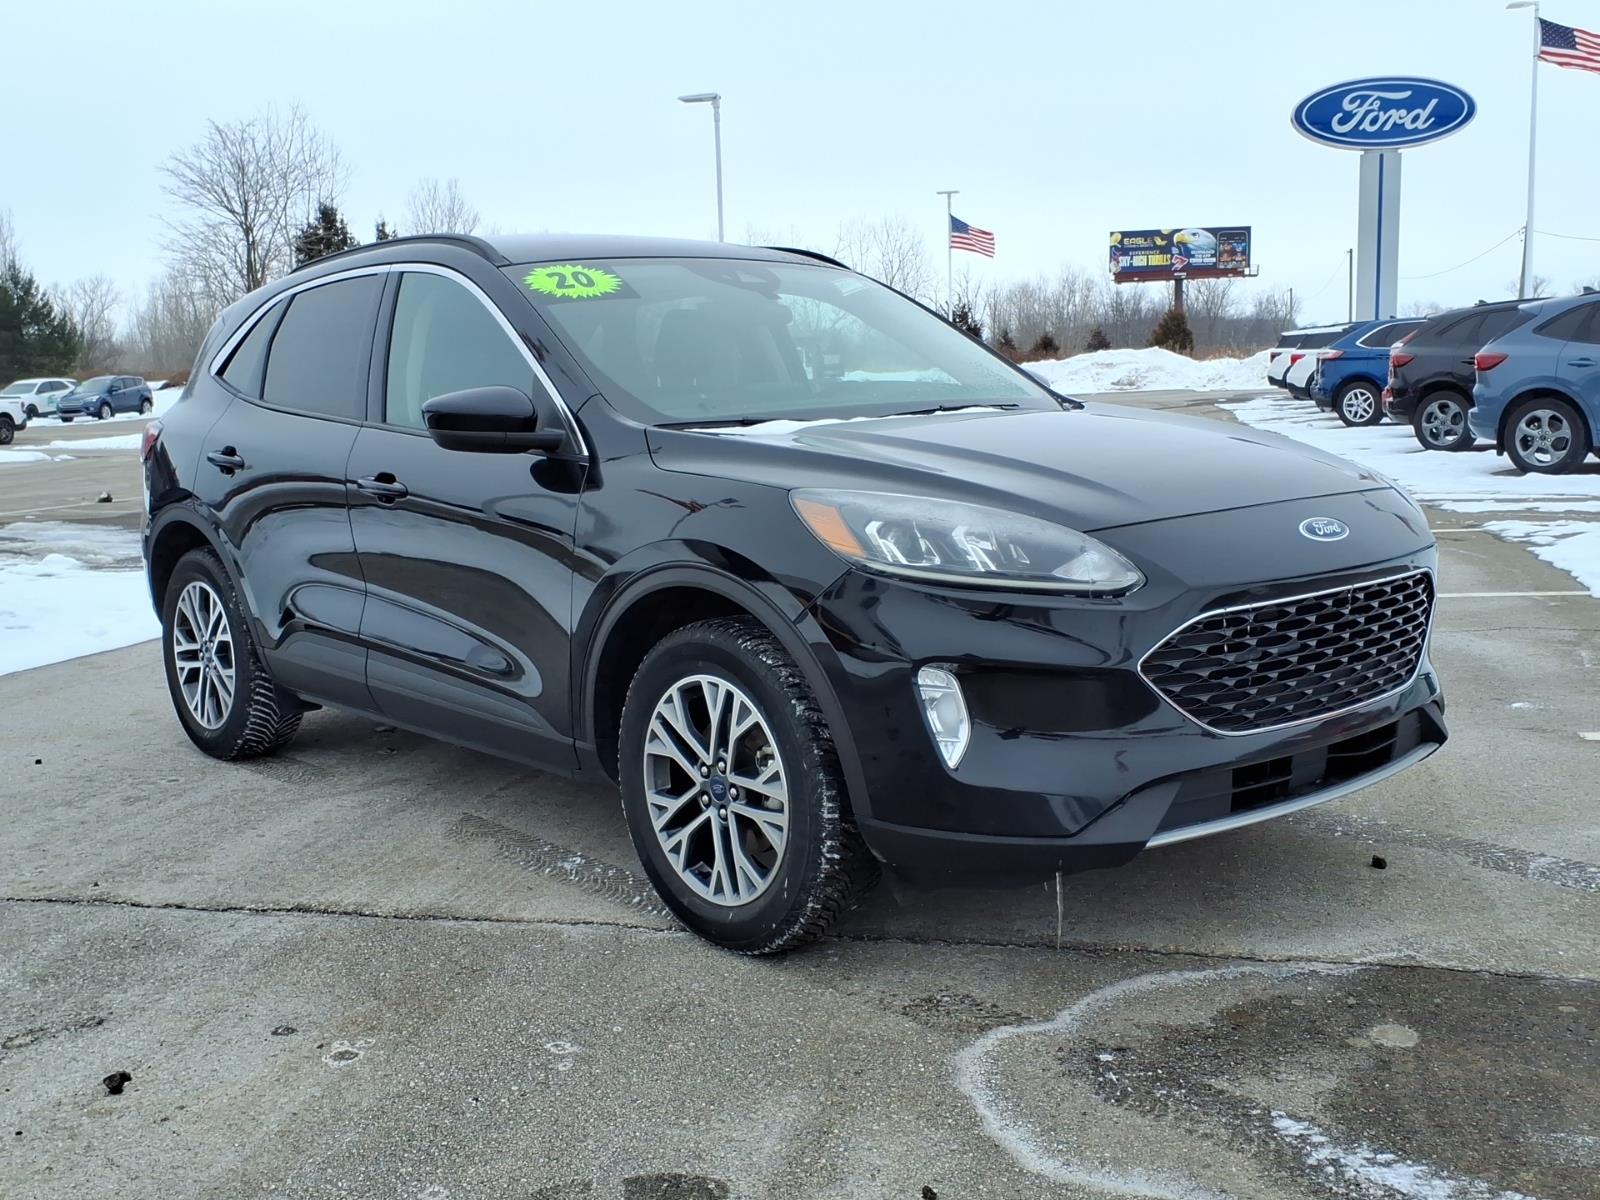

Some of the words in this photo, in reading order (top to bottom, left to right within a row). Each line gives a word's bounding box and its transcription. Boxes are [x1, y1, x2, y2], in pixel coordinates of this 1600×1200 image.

[1331, 91, 1439, 133] Ford
[1123, 237, 1153, 245] EAGLE
[546, 271, 596, 290] 20
[1312, 520, 1341, 535] Ford
